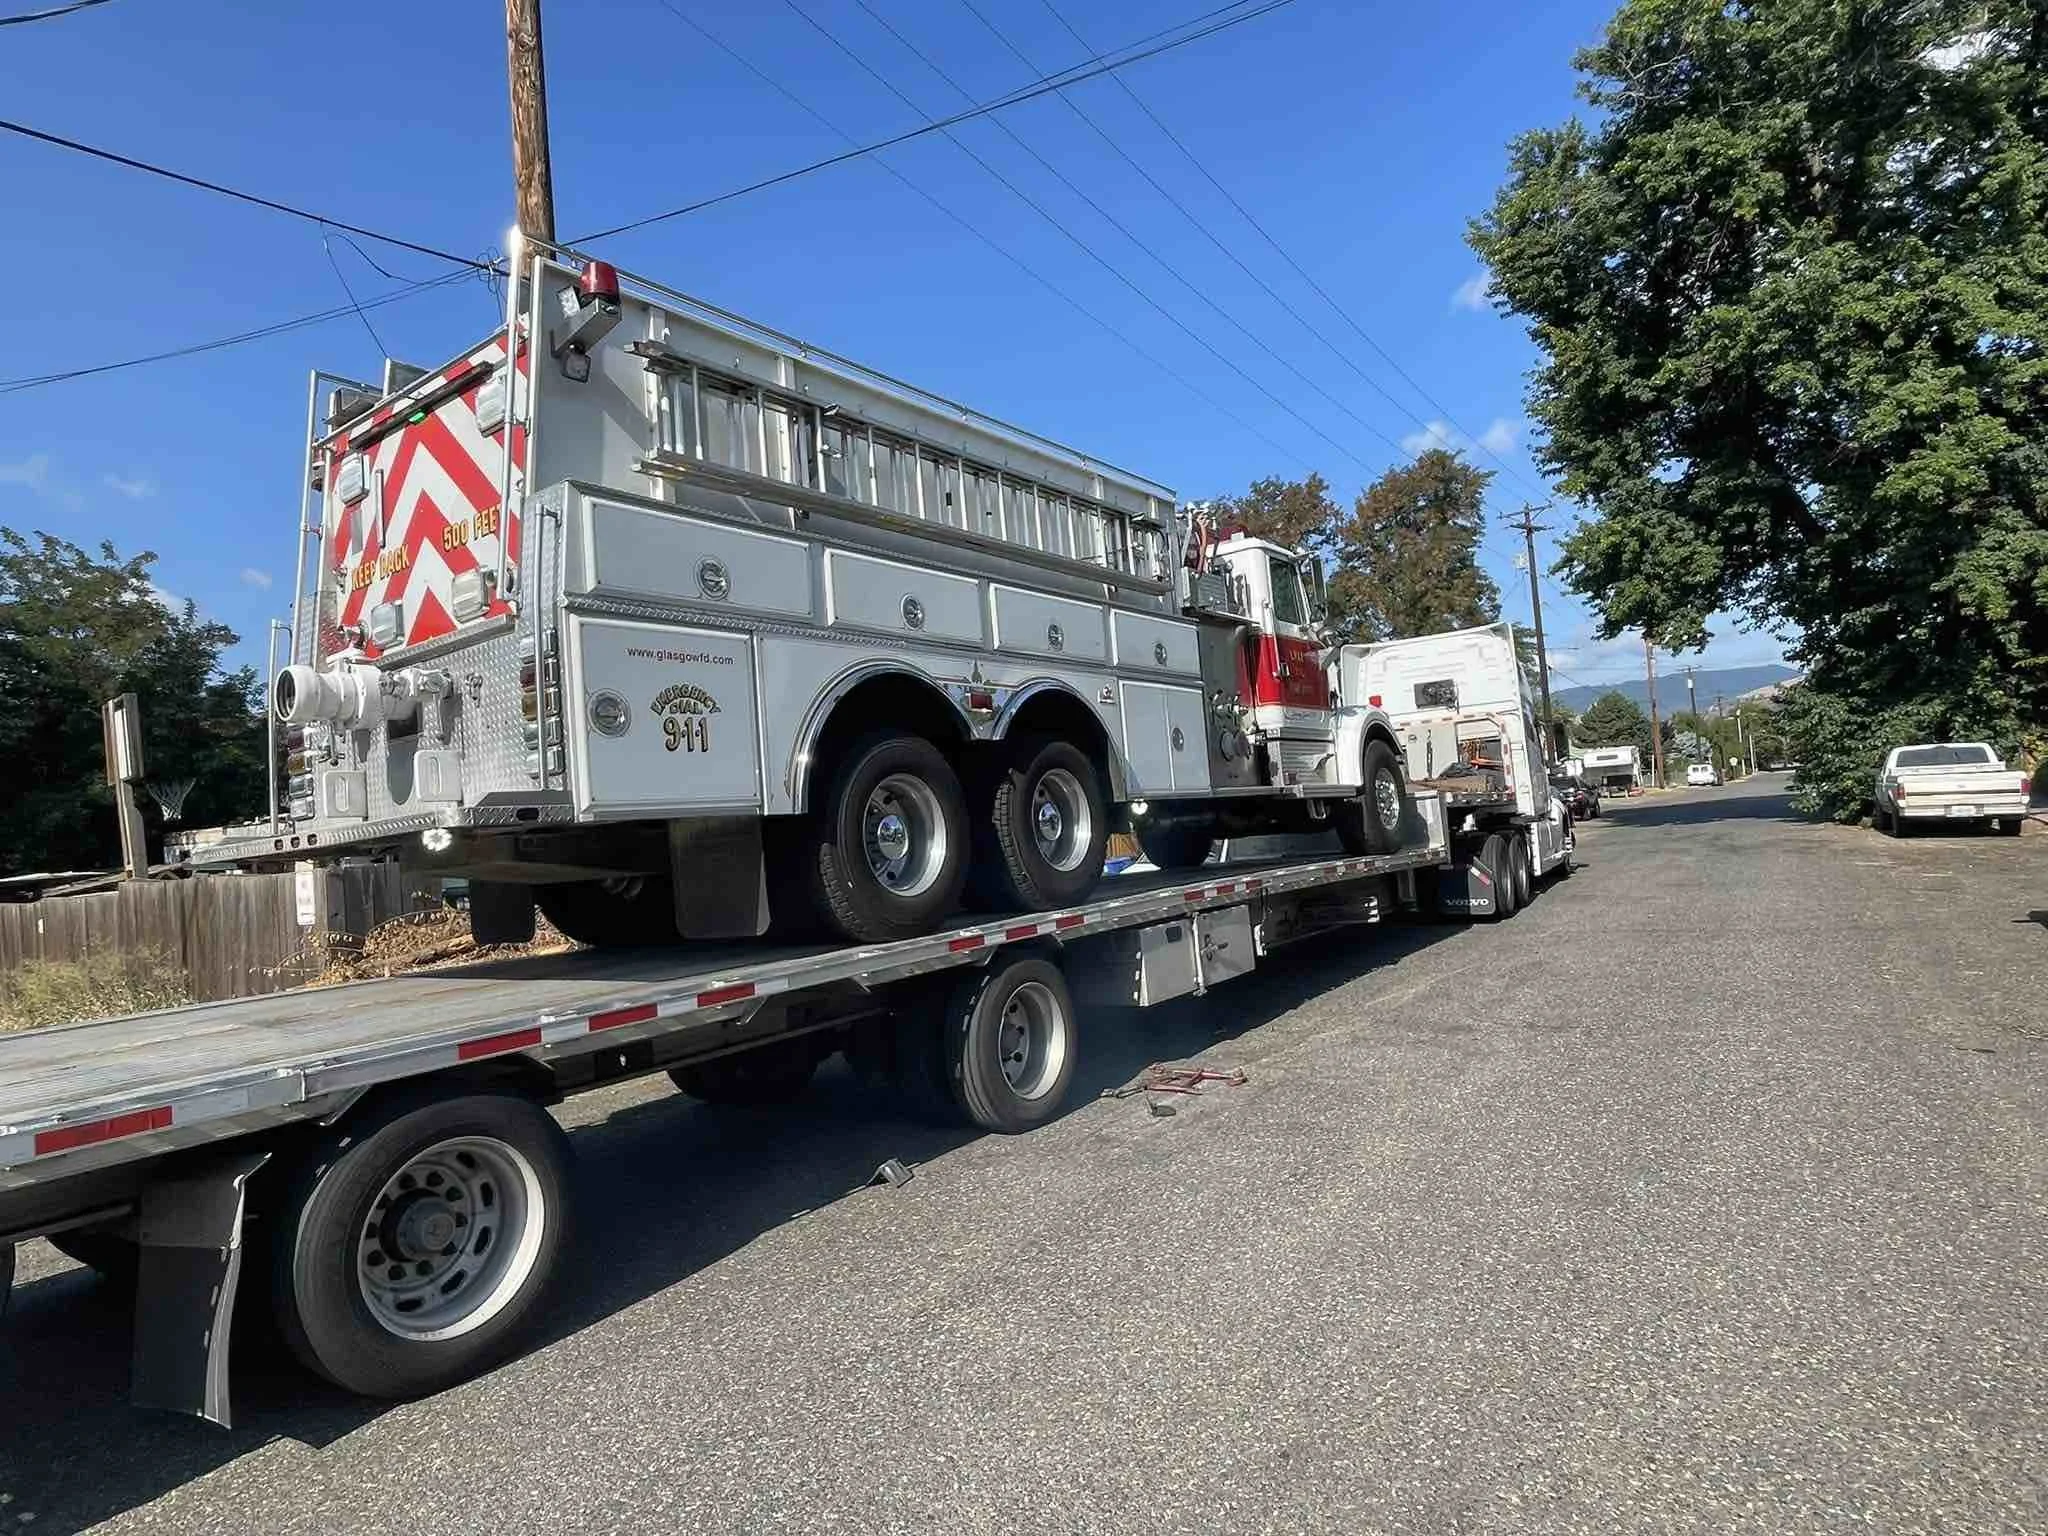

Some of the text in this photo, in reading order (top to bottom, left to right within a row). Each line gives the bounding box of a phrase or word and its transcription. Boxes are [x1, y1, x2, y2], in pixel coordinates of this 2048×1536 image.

[352, 559, 376, 592] KEEP
[380, 543, 409, 580] BACK
[442, 519, 469, 552] 500
[626, 647, 734, 664] www.glasgowfd.com
[650, 683, 721, 715] EMERGENCY
[670, 699, 703, 714] DIAL
[1446, 898, 1489, 906] VOLVO
